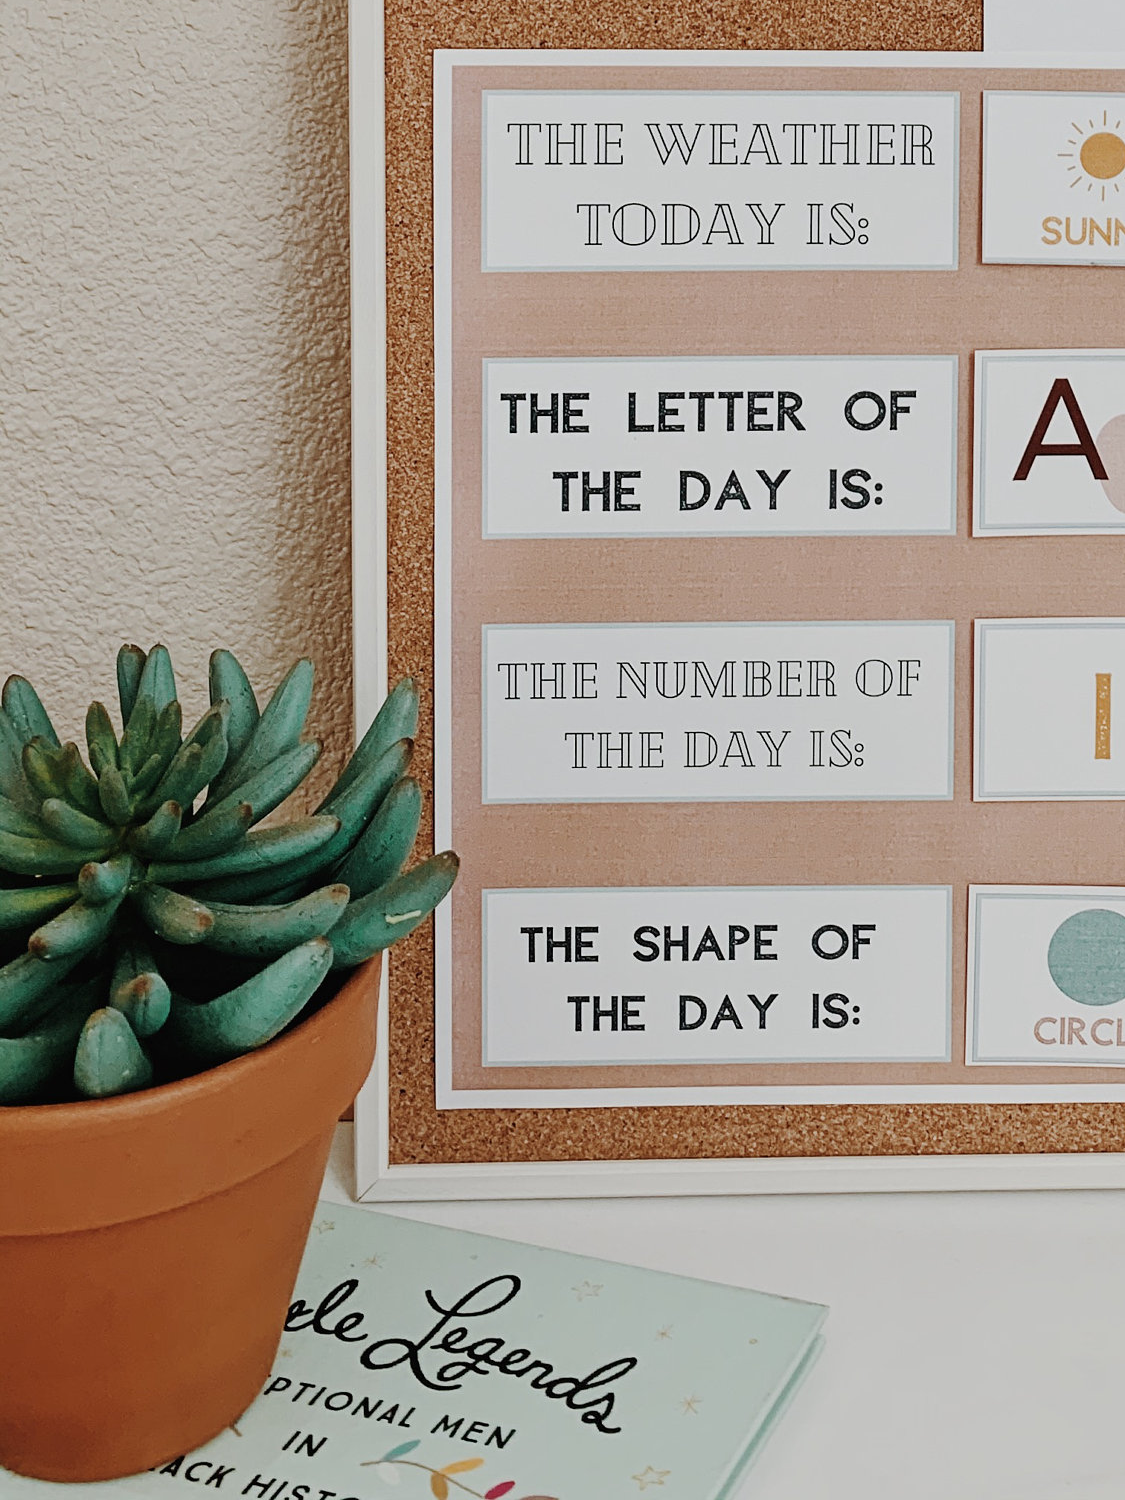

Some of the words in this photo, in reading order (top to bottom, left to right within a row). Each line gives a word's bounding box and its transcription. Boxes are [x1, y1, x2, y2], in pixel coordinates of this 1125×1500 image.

[507, 123, 623, 165] THE
[644, 124, 935, 165] WEATHER
[577, 203, 785, 246] TODAY
[806, 203, 869, 245] IS:
[500, 393, 589, 433] THE
[628, 391, 806, 432] LETTER
[844, 390, 916, 431] OF
[1013, 378, 1109, 481] A
[553, 471, 641, 511] THE
[679, 469, 791, 511] DAY
[829, 469, 883, 509] IS:
[498, 663, 597, 700] THE
[616, 661, 837, 698] NUMBER
[856, 660, 920, 697] OF
[565, 732, 663, 768] THE
[684, 731, 791, 767] DAY
[809, 730, 864, 767] IS:
[520, 926, 598, 962] THE
[633, 925, 778, 962] SHAPE
[812, 924, 876, 960] OF
[567, 996, 645, 1032] THE
[679, 994, 778, 1030] DAY
[812, 993, 860, 1028] IS:
[359, 1274, 637, 1434] Legends
[264, 1373, 416, 1428] PTIONAL
[430, 1415, 516, 1449] MEN
[282, 1431, 328, 1457] IN
[147, 1455, 236, 1488] ACK
